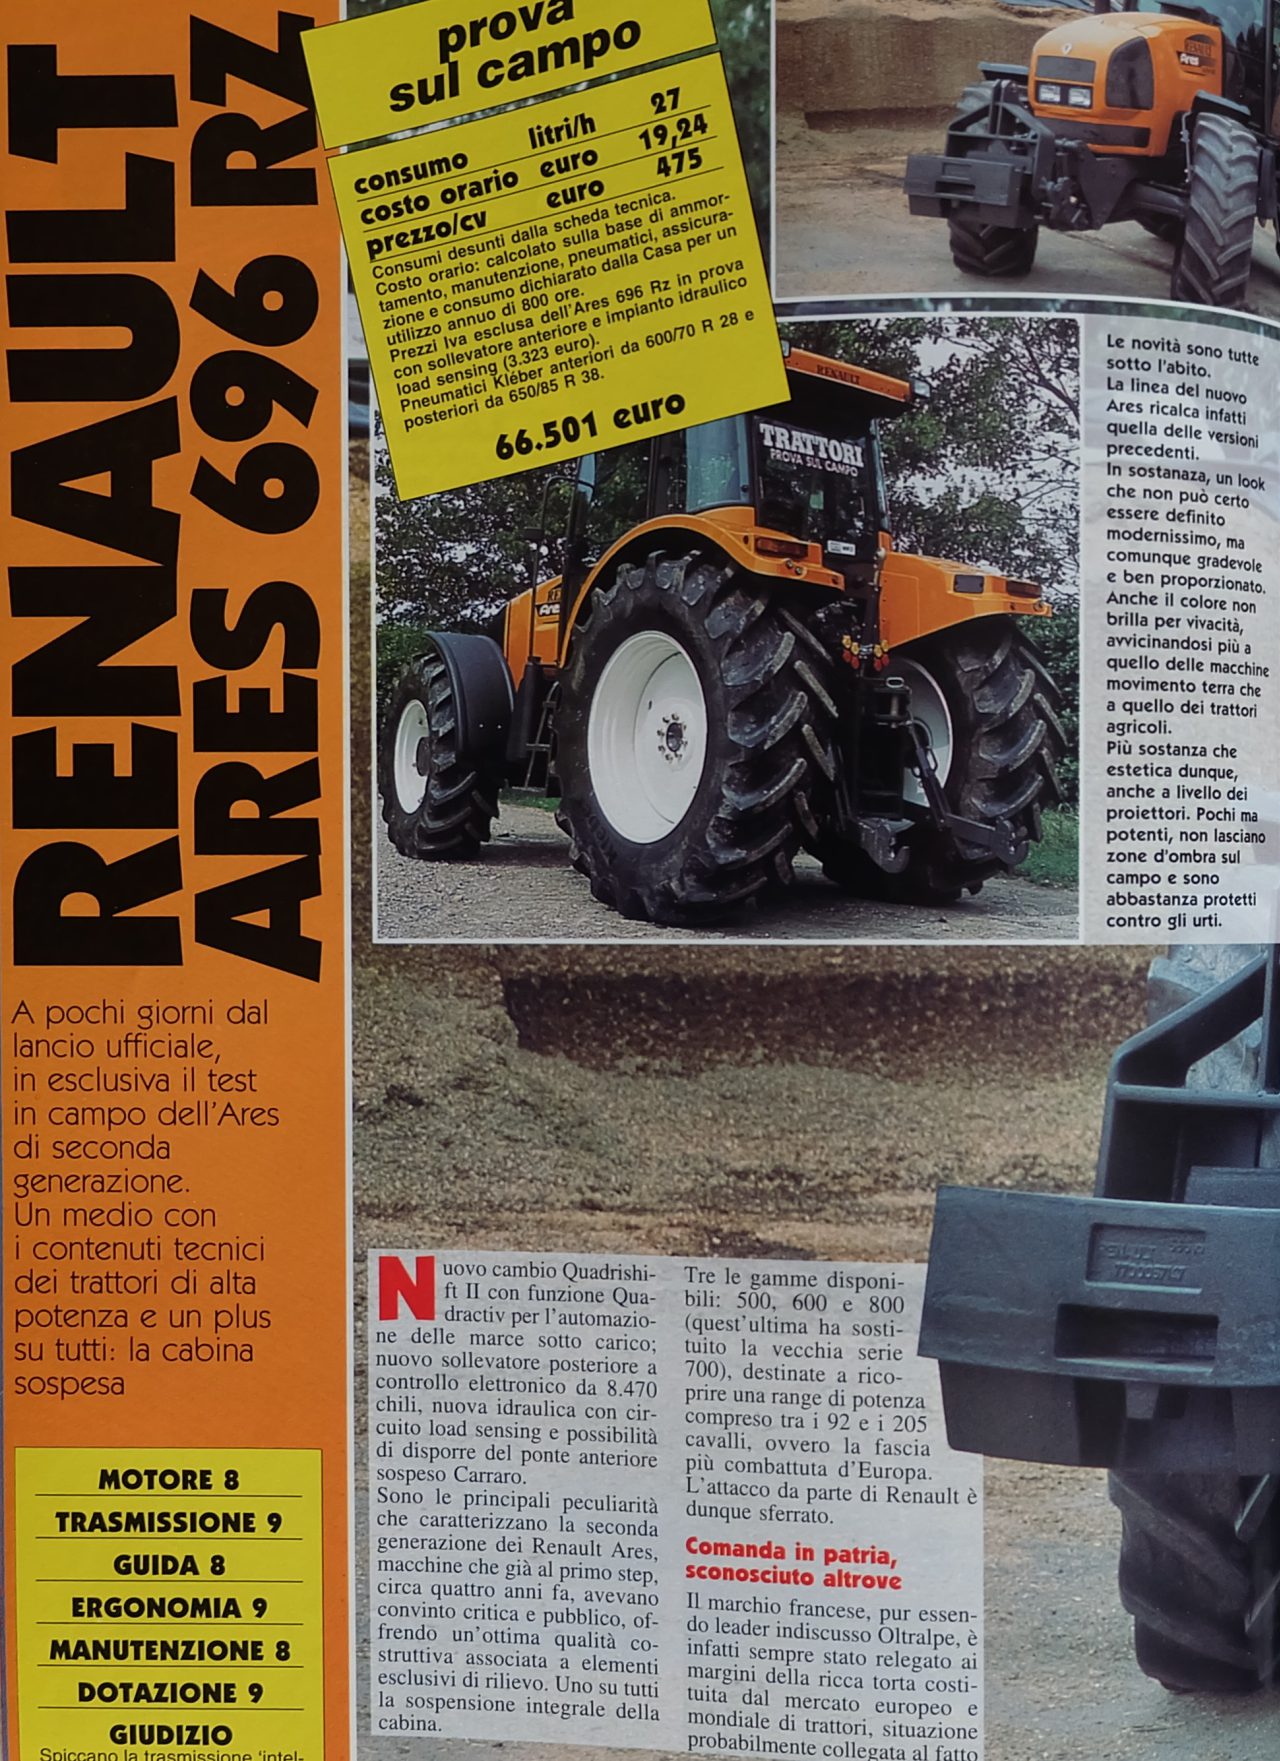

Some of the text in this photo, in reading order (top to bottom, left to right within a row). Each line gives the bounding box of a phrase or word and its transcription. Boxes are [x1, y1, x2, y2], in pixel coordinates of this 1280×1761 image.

[438, 0, 574, 64] prova
[390, 20, 640, 112] sul campo
[354, 86, 681, 195] consumo litri/h 27
[360, 113, 708, 225] costo orario euro 19,24
[366, 147, 704, 261] prezzo/cv euro 475
[372, 191, 676, 279] Consumi desunti dalla scheda tecnica.
[386, 288, 585, 346] utilizzo annuo di 800 ore.
[1107, 333, 1260, 367] Le novità sono tutte
[404, 368, 605, 433] posteriori da 650/85 R 38.
[496, 394, 686, 461] 66.501 euro
[759, 423, 864, 468] TRATTORI
[769, 448, 859, 477] PROVA SUL CAMPO
[1106, 462, 1266, 492] In sostanaza, un look
[6, 45, 182, 967] RENAULT
[190, 11, 321, 983] ARES 696 RZ
[1107, 527, 1245, 550] modernissimo, ma
[1106, 569, 1267, 595] e ben proporzionato.
[1107, 739, 1238, 759] Più sostanza che
[1106, 762, 1239, 783] estetica dunque,
[1106, 805, 1259, 823] proiettori. Pochi ma
[1106, 913, 1223, 931] contro gli urti.
[10, 998, 268, 1031] A pochi giorni dal
[14, 1032, 221, 1065] lancio ufficiale,
[14, 1066, 258, 1093] in esclusiva il test
[14, 1100, 280, 1132] in campo dell'Ares
[13, 1133, 170, 1160] di seconda
[13, 1168, 190, 1199] generazione.
[15, 1201, 216, 1228] Un medio con
[15, 1234, 265, 1262] i contenuti tecnici
[14, 1268, 256, 1295] dei trattori di alta
[443, 1261, 657, 1283] uovo cambio Quadrishi-
[15, 1303, 272, 1335] potenza e un plus
[14, 1336, 254, 1363] su tutti: la cabina
[14, 1376, 125, 1401] sospesa
[98, 1469, 240, 1491] MOTORE 8
[377, 1465, 527, 1486] sospeso Carraro.
[55, 1511, 283, 1534] TRASMISSIONE 9
[686, 1499, 834, 1525] dunque sferrato.
[377, 1533, 658, 1563] generazione dei Renault Ares,
[686, 1536, 898, 1570] Comanda in patria,
[113, 1554, 226, 1576] GUIDA 8
[685, 1565, 902, 1590] sconosciuto altrove
[72, 1597, 268, 1619] ERGONOMIA 9
[49, 1639, 291, 1662] MANUTENZIONE 8
[78, 1682, 264, 1704] DOTAZIONE 9
[109, 1724, 233, 1746] GIUDIZIO
[688, 1710, 978, 1740] mondiale di trattori, situazione
